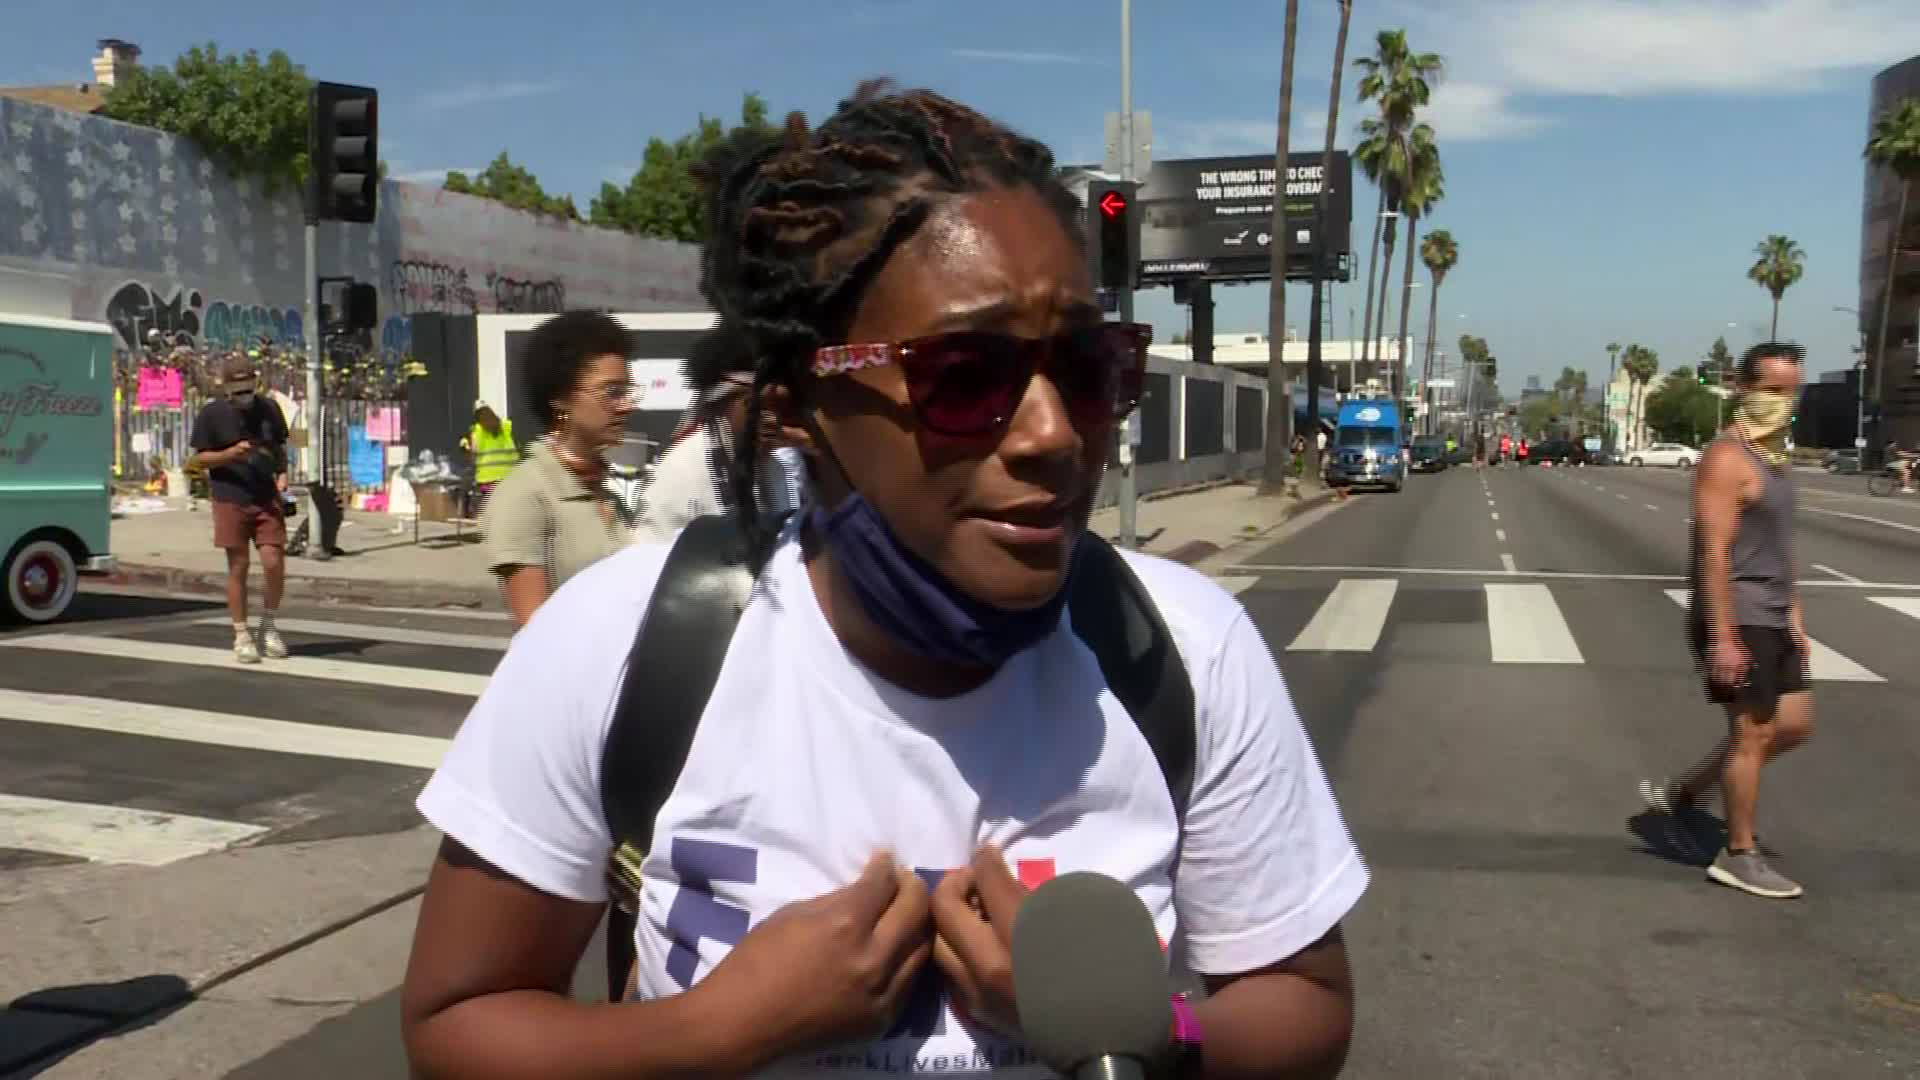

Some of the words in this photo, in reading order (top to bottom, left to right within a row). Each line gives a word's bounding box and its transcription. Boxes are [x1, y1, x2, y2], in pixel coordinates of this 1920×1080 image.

[1200, 172, 1218, 185] THE
[1220, 170, 1257, 184] WRONG
[1258, 168, 1277, 182] TIM
[1298, 165, 1324, 180] CHEC
[1196, 187, 1222, 200] YOUR
[1223, 184, 1277, 199] INSURANC
